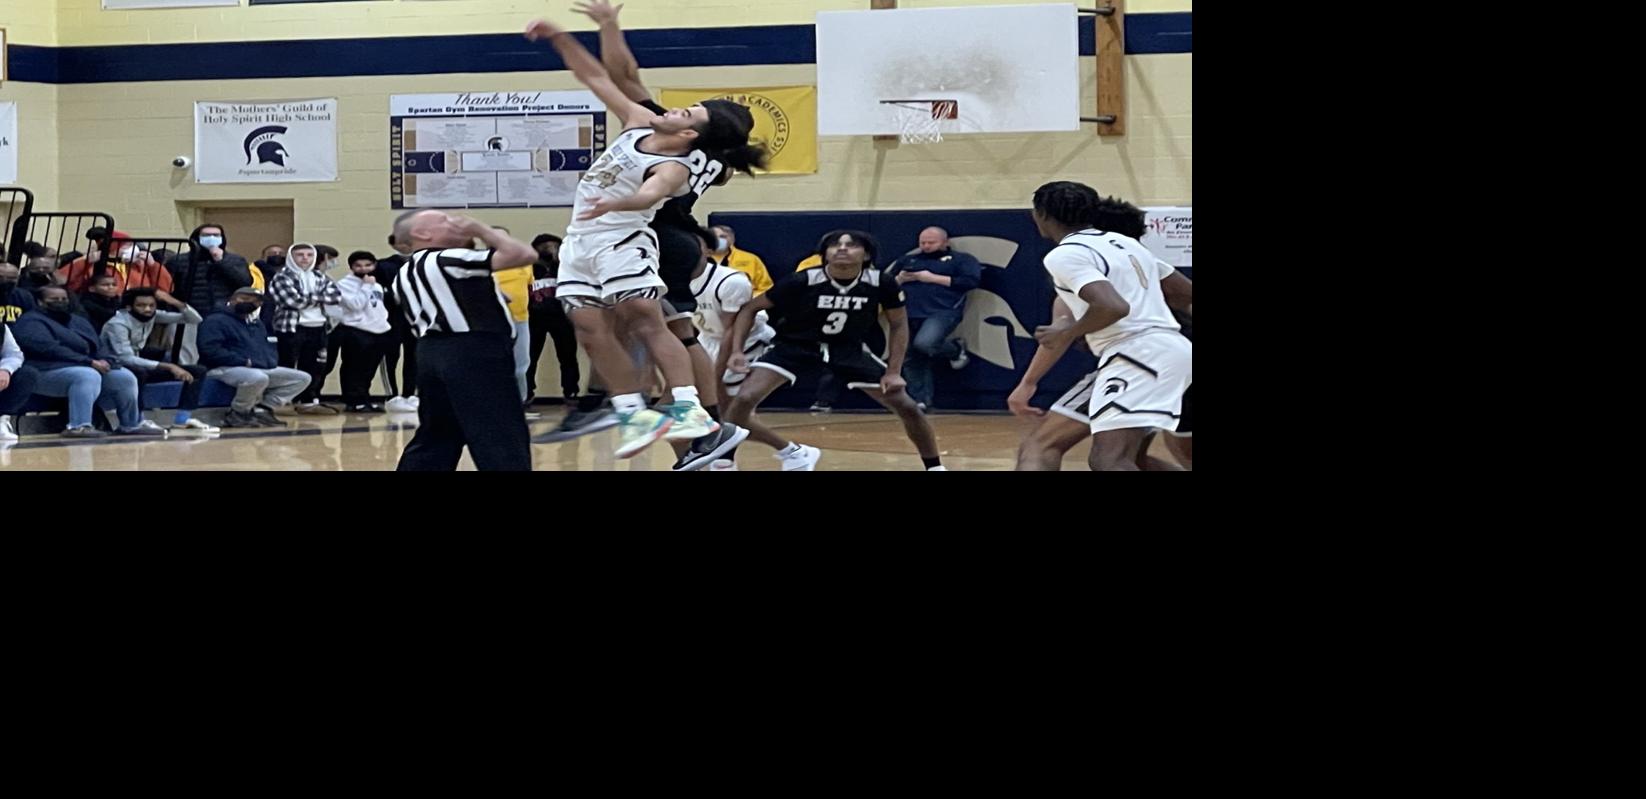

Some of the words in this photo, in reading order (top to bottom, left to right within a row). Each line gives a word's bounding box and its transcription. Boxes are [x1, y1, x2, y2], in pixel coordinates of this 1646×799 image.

[455, 92, 500, 105] Thank
[505, 91, 541, 104] You!
[207, 106, 228, 114] The
[282, 103, 313, 112] Guild
[316, 103, 327, 111] of
[408, 106, 443, 114] Spartan
[468, 105, 519, 113] Renovation
[203, 115, 227, 124] Holy
[232, 114, 262, 124] Spirit
[266, 113, 291, 122] High
[295, 112, 331, 121] School
[392, 125, 401, 168] SPIRIT
[392, 170, 402, 201] HOLY
[817, 295, 868, 310] EHT
[822, 312, 848, 335] 3
